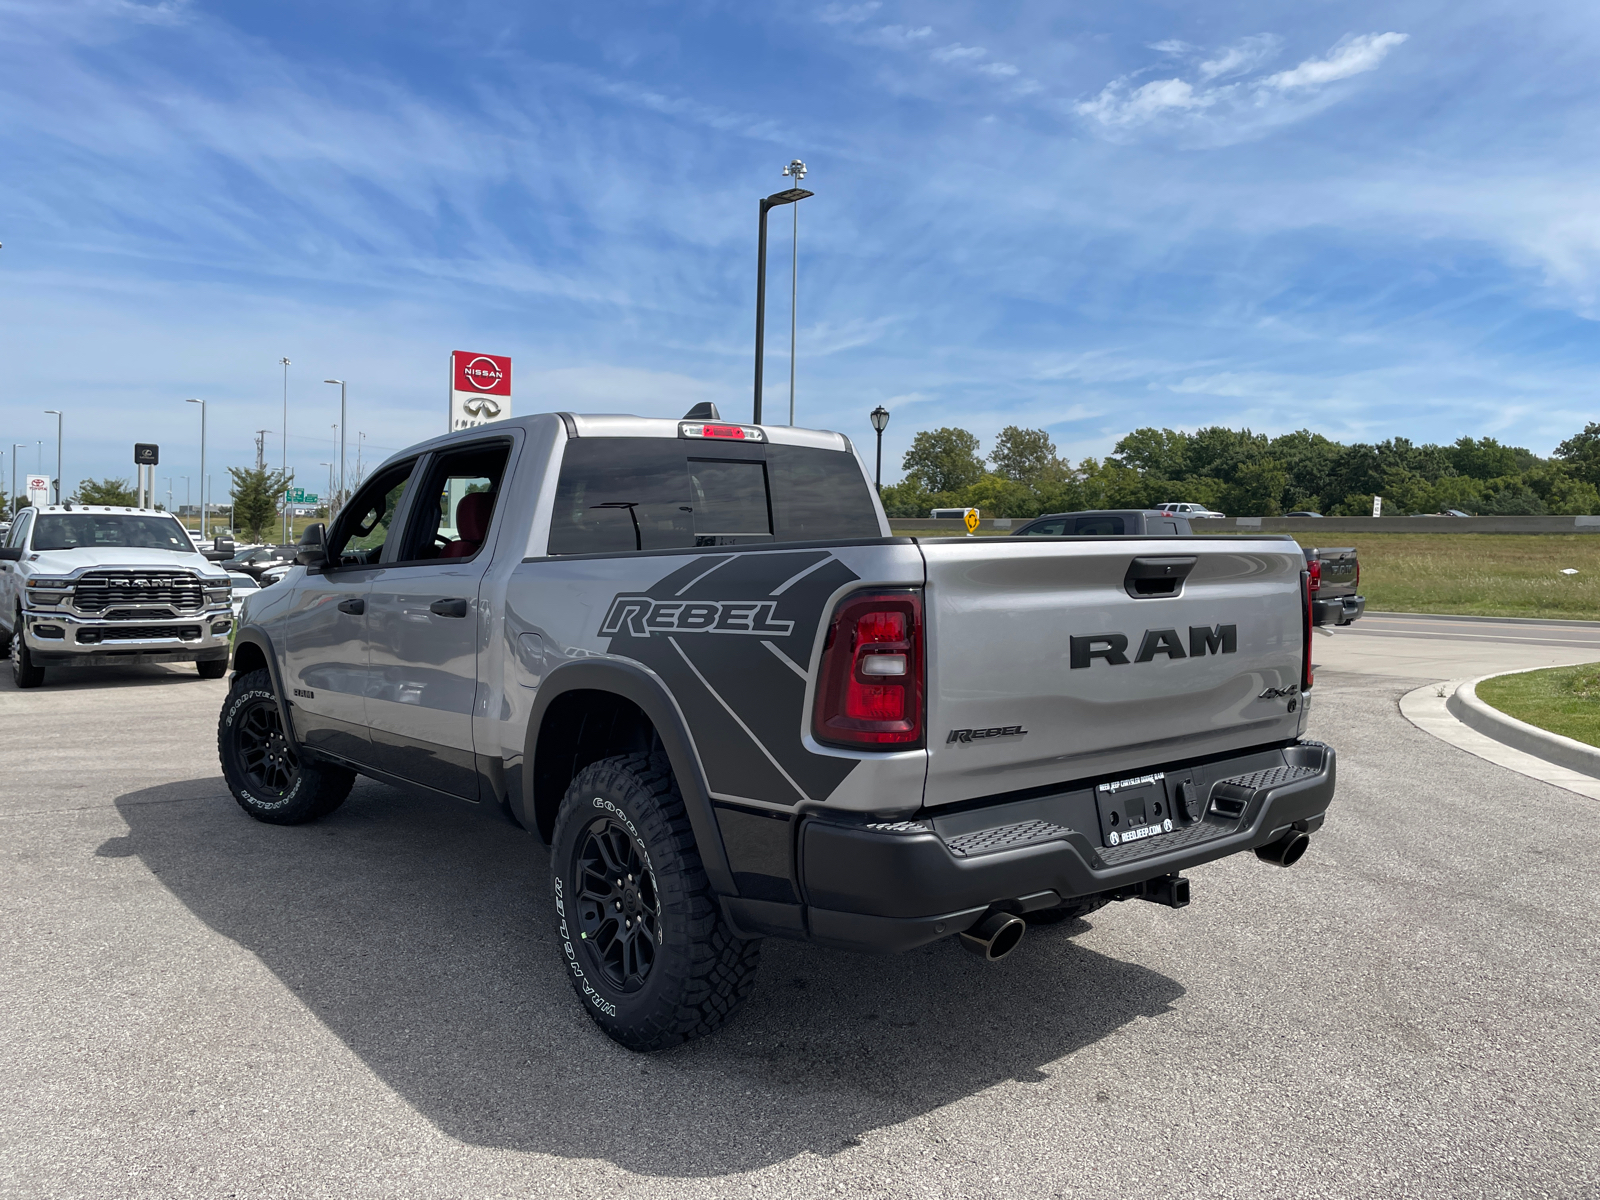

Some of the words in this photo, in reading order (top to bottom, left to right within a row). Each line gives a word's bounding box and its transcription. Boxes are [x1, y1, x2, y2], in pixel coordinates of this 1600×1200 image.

[464, 367, 503, 378] NISSAN
[455, 419, 489, 428] INFI
[109, 578, 172, 588] RAM
[602, 596, 796, 637] REBEL
[1069, 624, 1238, 670] RAM
[293, 688, 315, 699] RAM
[225, 690, 279, 727] GOODYEA
[946, 725, 1029, 744] REBEL
[1110, 781, 1121, 790] JEEP
[1120, 777, 1140, 787] CHRYSLER
[1154, 772, 1165, 780] RAM
[1121, 825, 1162, 842] REEDJEEP.COM
[554, 876, 616, 1018] WRANGLER
